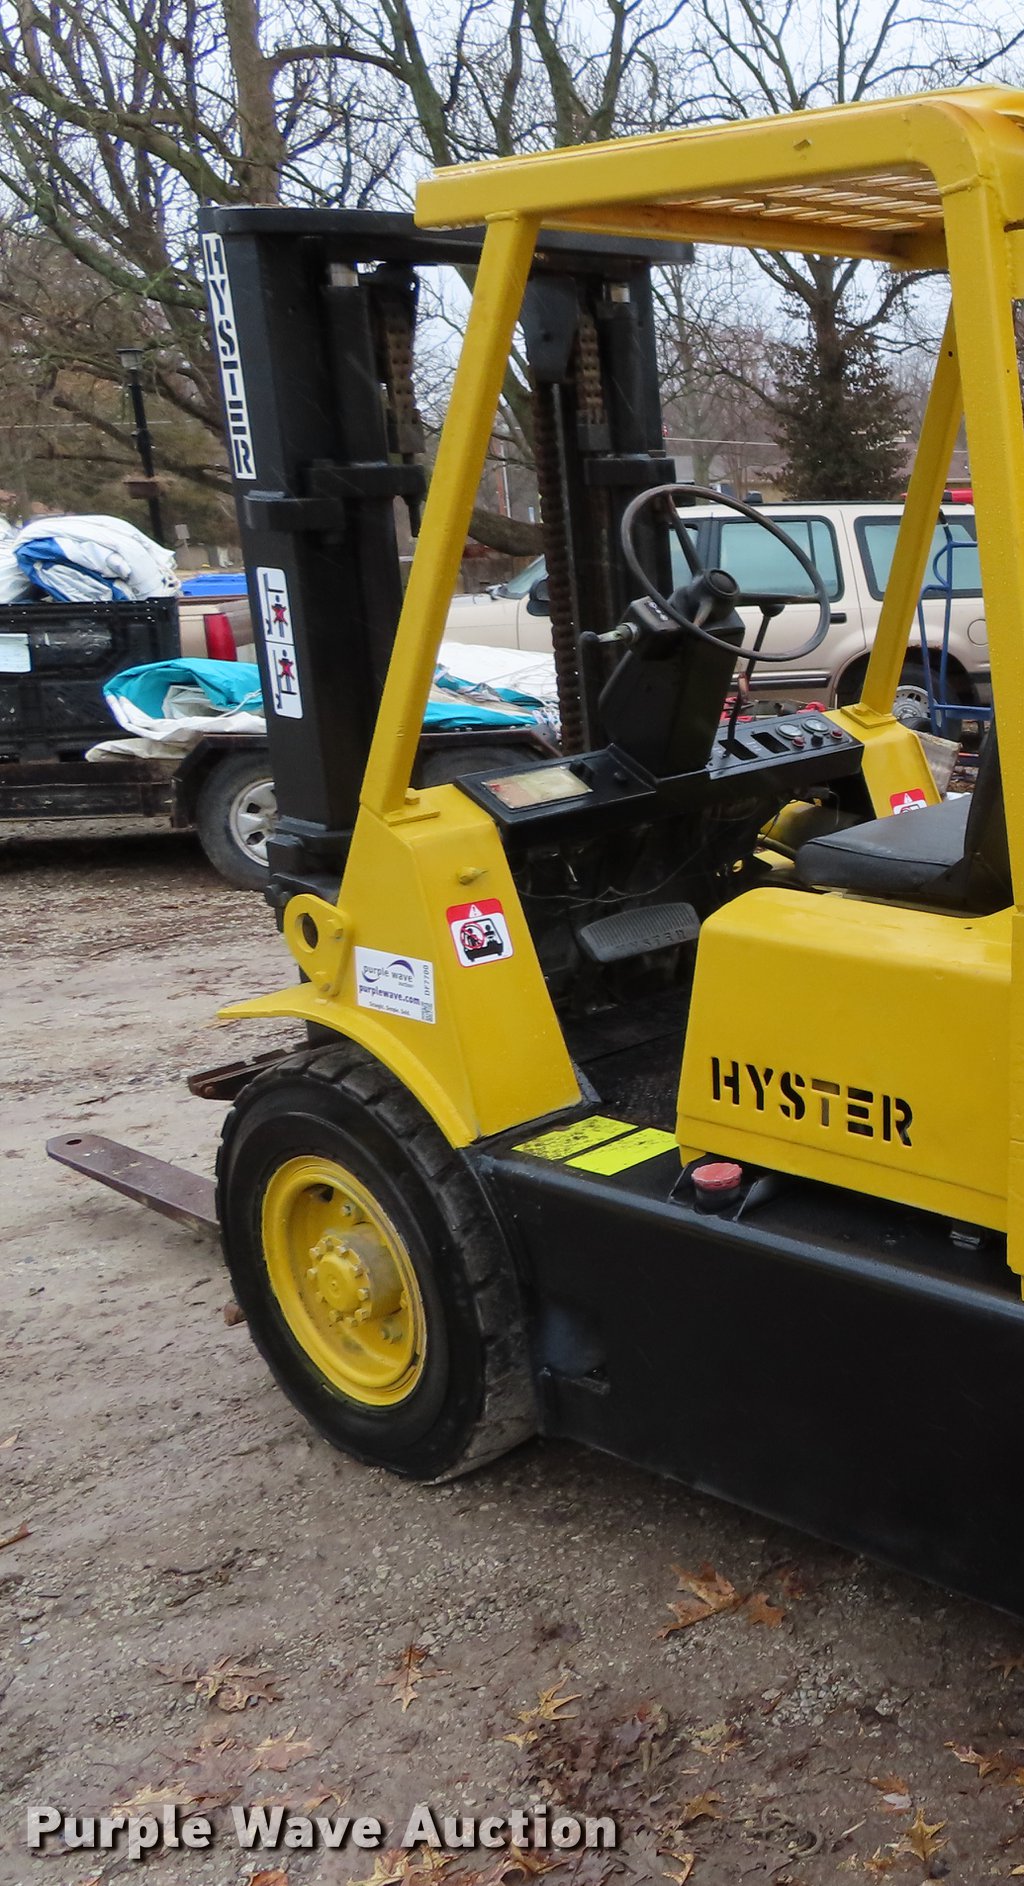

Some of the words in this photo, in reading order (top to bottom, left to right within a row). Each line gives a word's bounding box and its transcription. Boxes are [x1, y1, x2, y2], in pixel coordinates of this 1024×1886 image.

[204, 238, 254, 475] HYSTER
[359, 984, 421, 1006] purplewave.com
[363, 965, 390, 978] purple
[391, 971, 413, 983] wave
[711, 1056, 913, 1147] HYSTER
